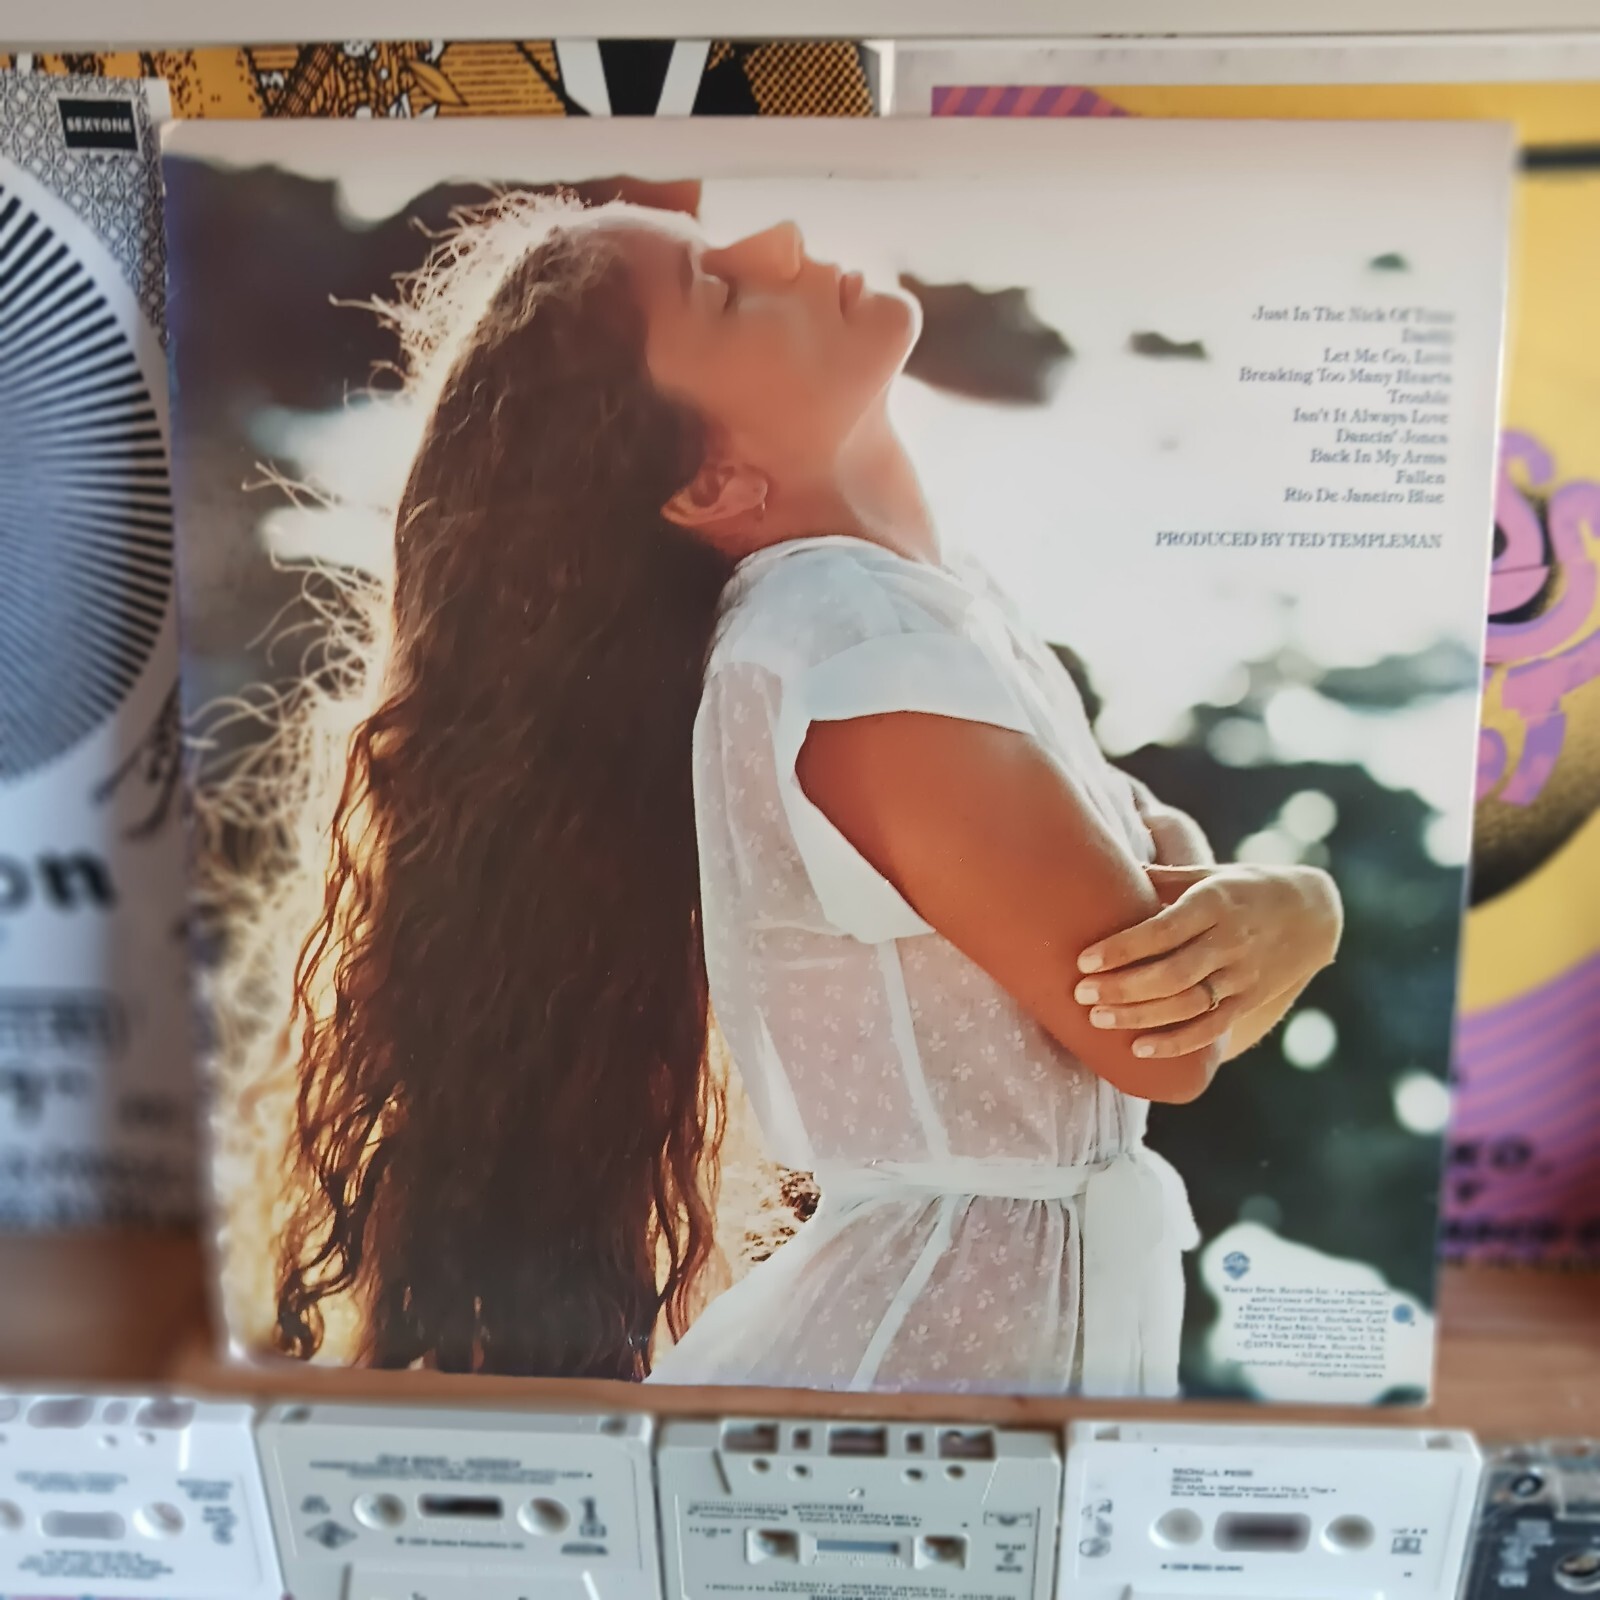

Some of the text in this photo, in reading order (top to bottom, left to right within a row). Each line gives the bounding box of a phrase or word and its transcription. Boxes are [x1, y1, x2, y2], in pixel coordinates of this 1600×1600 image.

[1253, 306, 1288, 321] Just
[1293, 306, 1310, 321] In
[1314, 306, 1345, 321] The
[1350, 307, 1386, 322] Nick
[1389, 308, 1409, 323] Of
[1323, 348, 1350, 363] Let
[1354, 348, 1379, 364] Me
[1239, 367, 1452, 387] Breaking Too Many Hearts
[1293, 408, 1449, 426] Isn't It Always Love
[1335, 429, 1449, 445] Dancin' Jones
[1310, 448, 1447, 467] Back In My Arms
[1395, 470, 1446, 485] Fallen
[1283, 488, 1445, 504] Rio De Janeiro Blue
[1155, 531, 1443, 549] PRODUCED BY TED TEMPLEMAN
